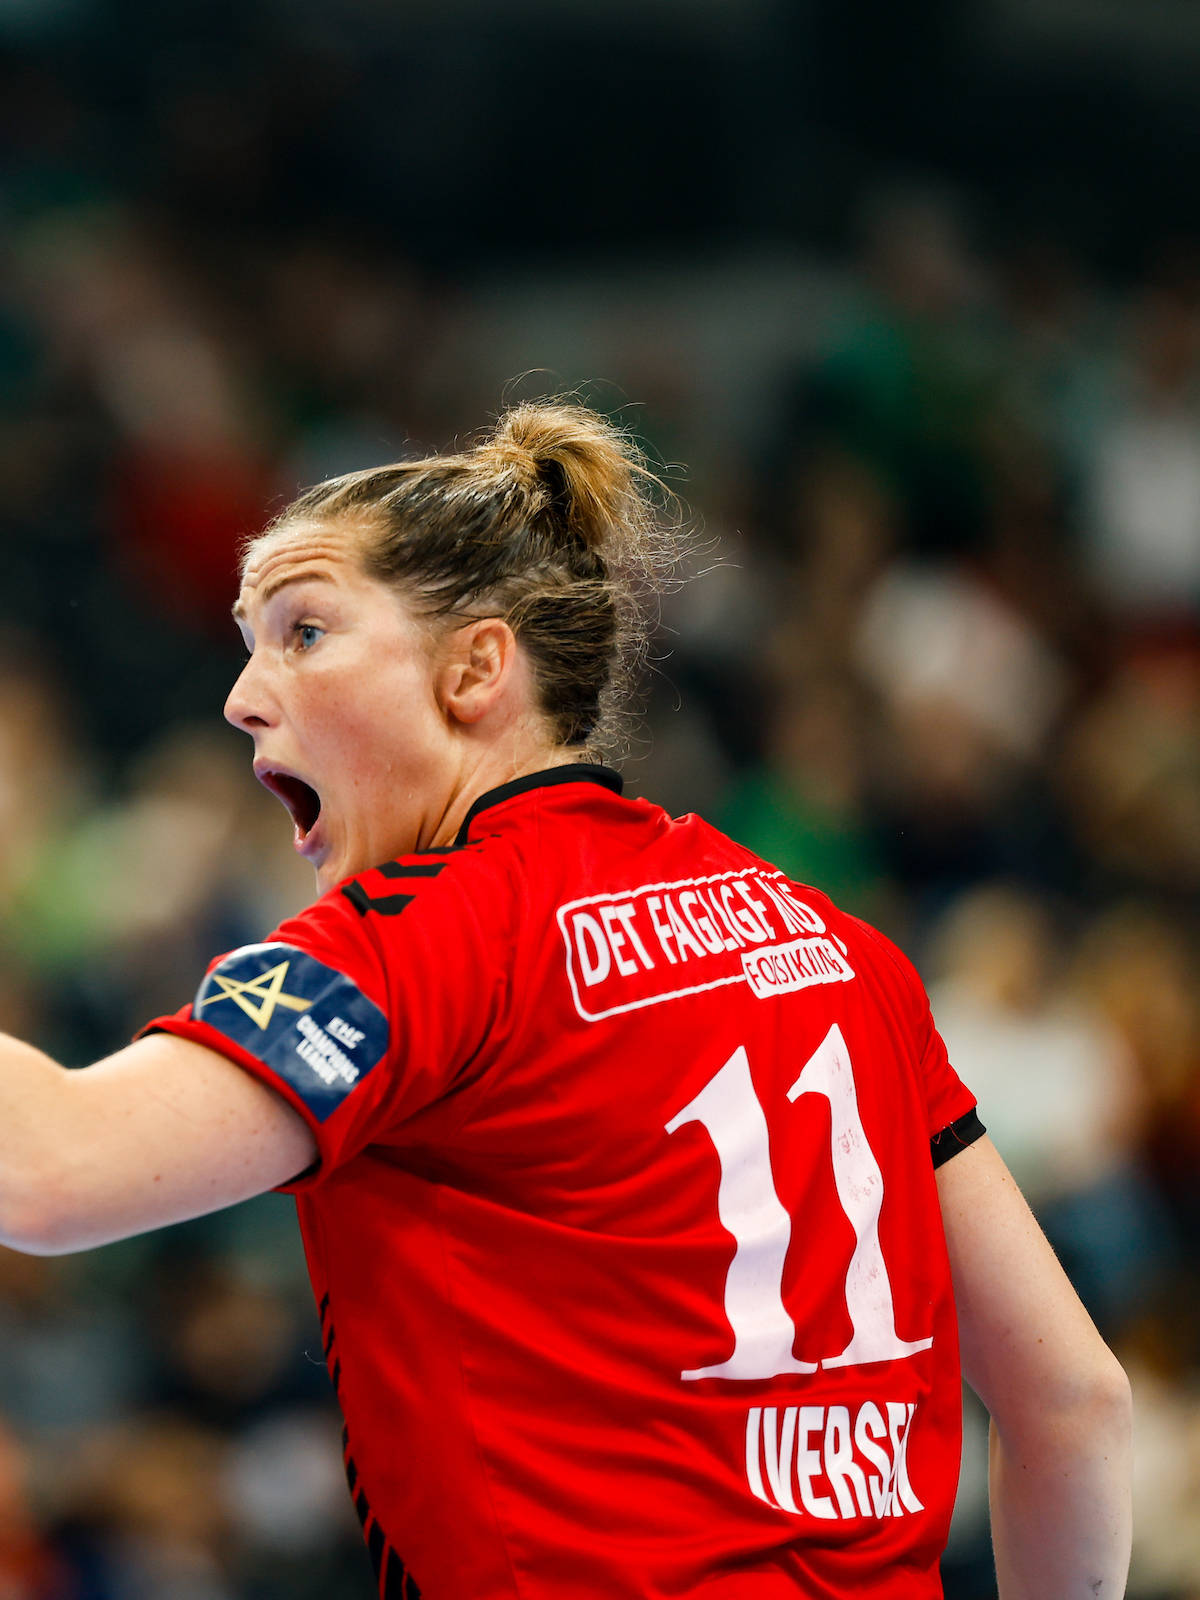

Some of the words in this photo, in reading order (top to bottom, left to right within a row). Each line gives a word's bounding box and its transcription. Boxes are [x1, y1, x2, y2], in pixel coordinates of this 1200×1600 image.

[571, 903, 655, 987] DET
[646, 880, 776, 964] FAGLIGE
[296, 1014, 360, 1084] CHAMPIONS
[296, 1037, 340, 1085] LEAGUE
[664, 1023, 933, 1381] 11
